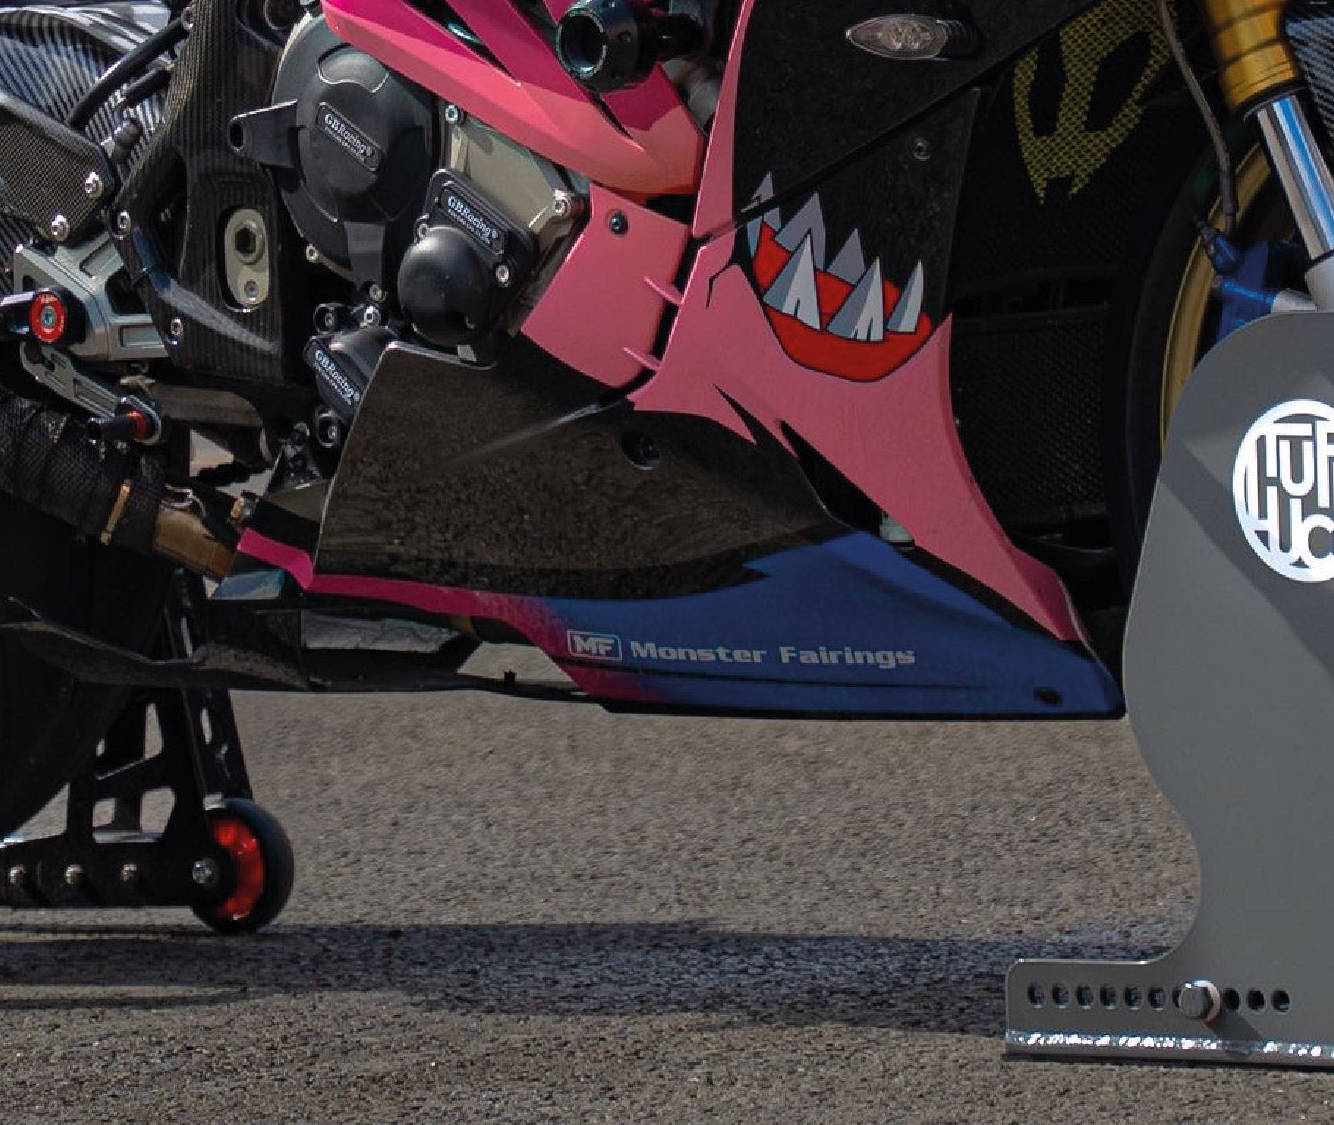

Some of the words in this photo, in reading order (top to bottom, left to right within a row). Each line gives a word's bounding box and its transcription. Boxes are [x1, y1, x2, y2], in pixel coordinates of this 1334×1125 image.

[572, 634, 615, 656] MF
[629, 640, 767, 663] Monster
[778, 646, 917, 669] Fairings
